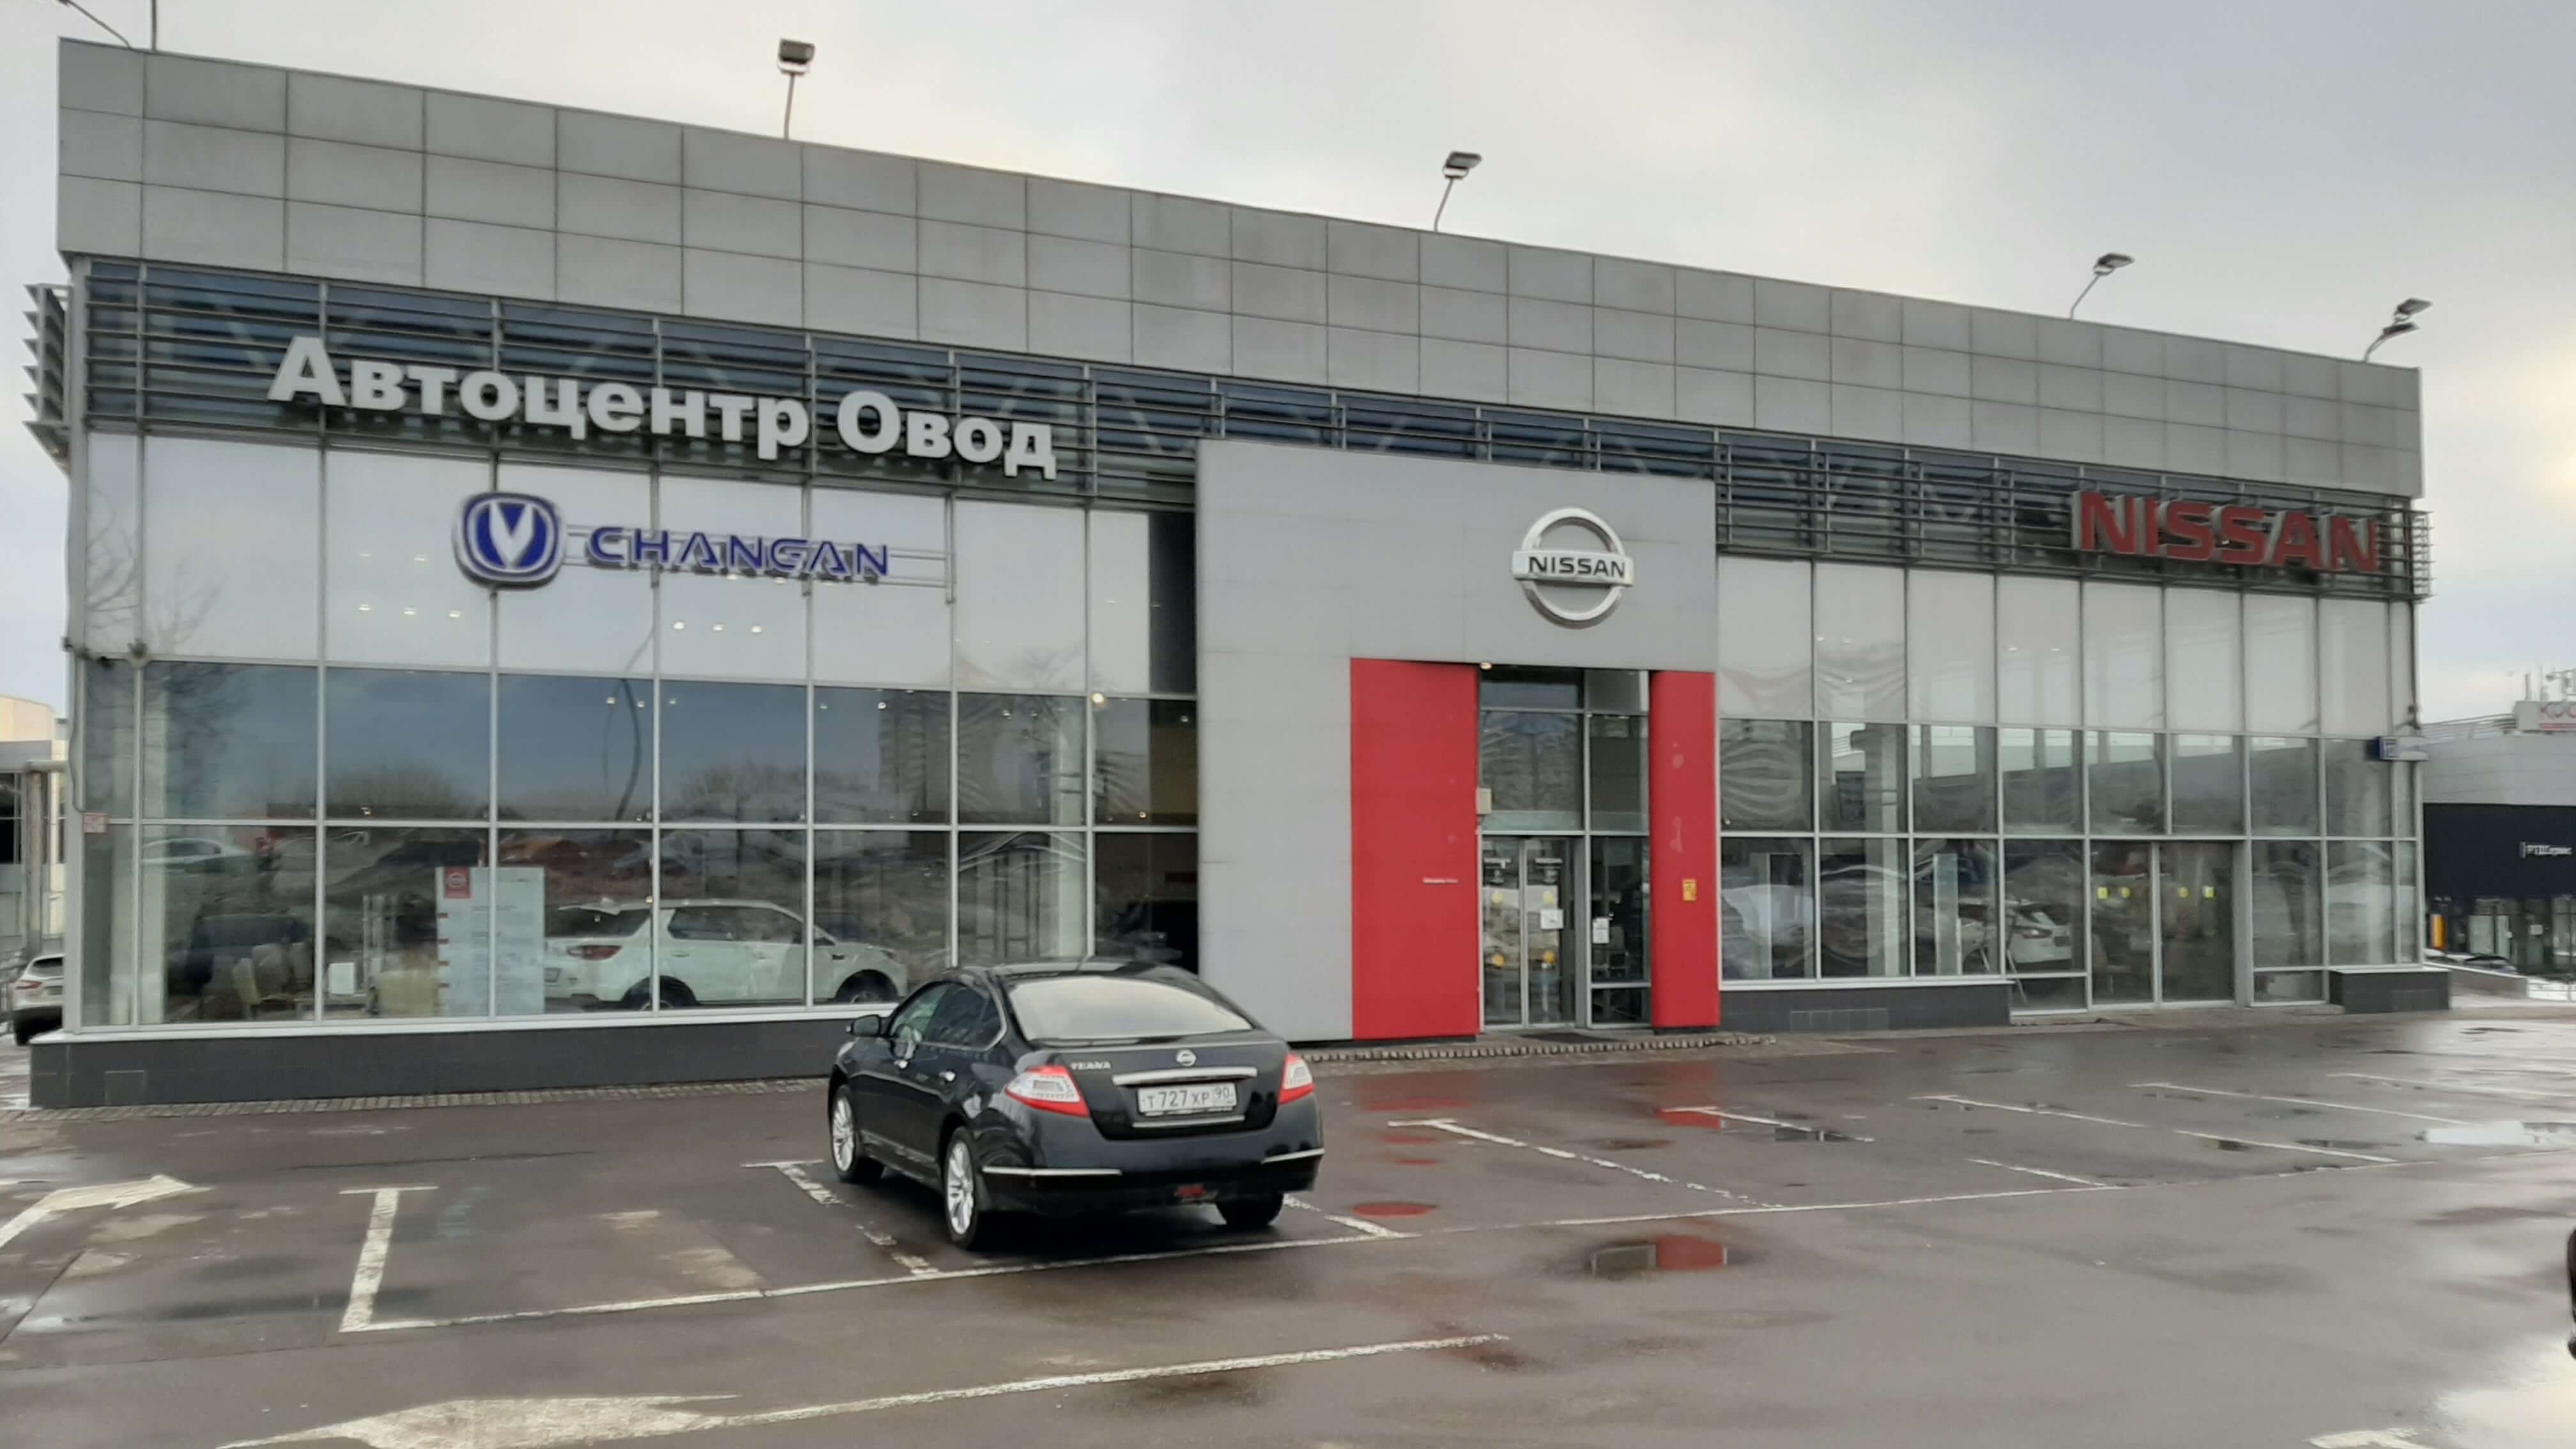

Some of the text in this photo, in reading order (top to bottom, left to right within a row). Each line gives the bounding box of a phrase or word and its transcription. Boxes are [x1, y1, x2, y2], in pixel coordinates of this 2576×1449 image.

[267, 335, 1057, 480] Автоцентр Овод
[590, 526, 889, 576] CHANGAN
[2075, 491, 2379, 572] NISSAN
[1528, 555, 1626, 579] NISSAN
